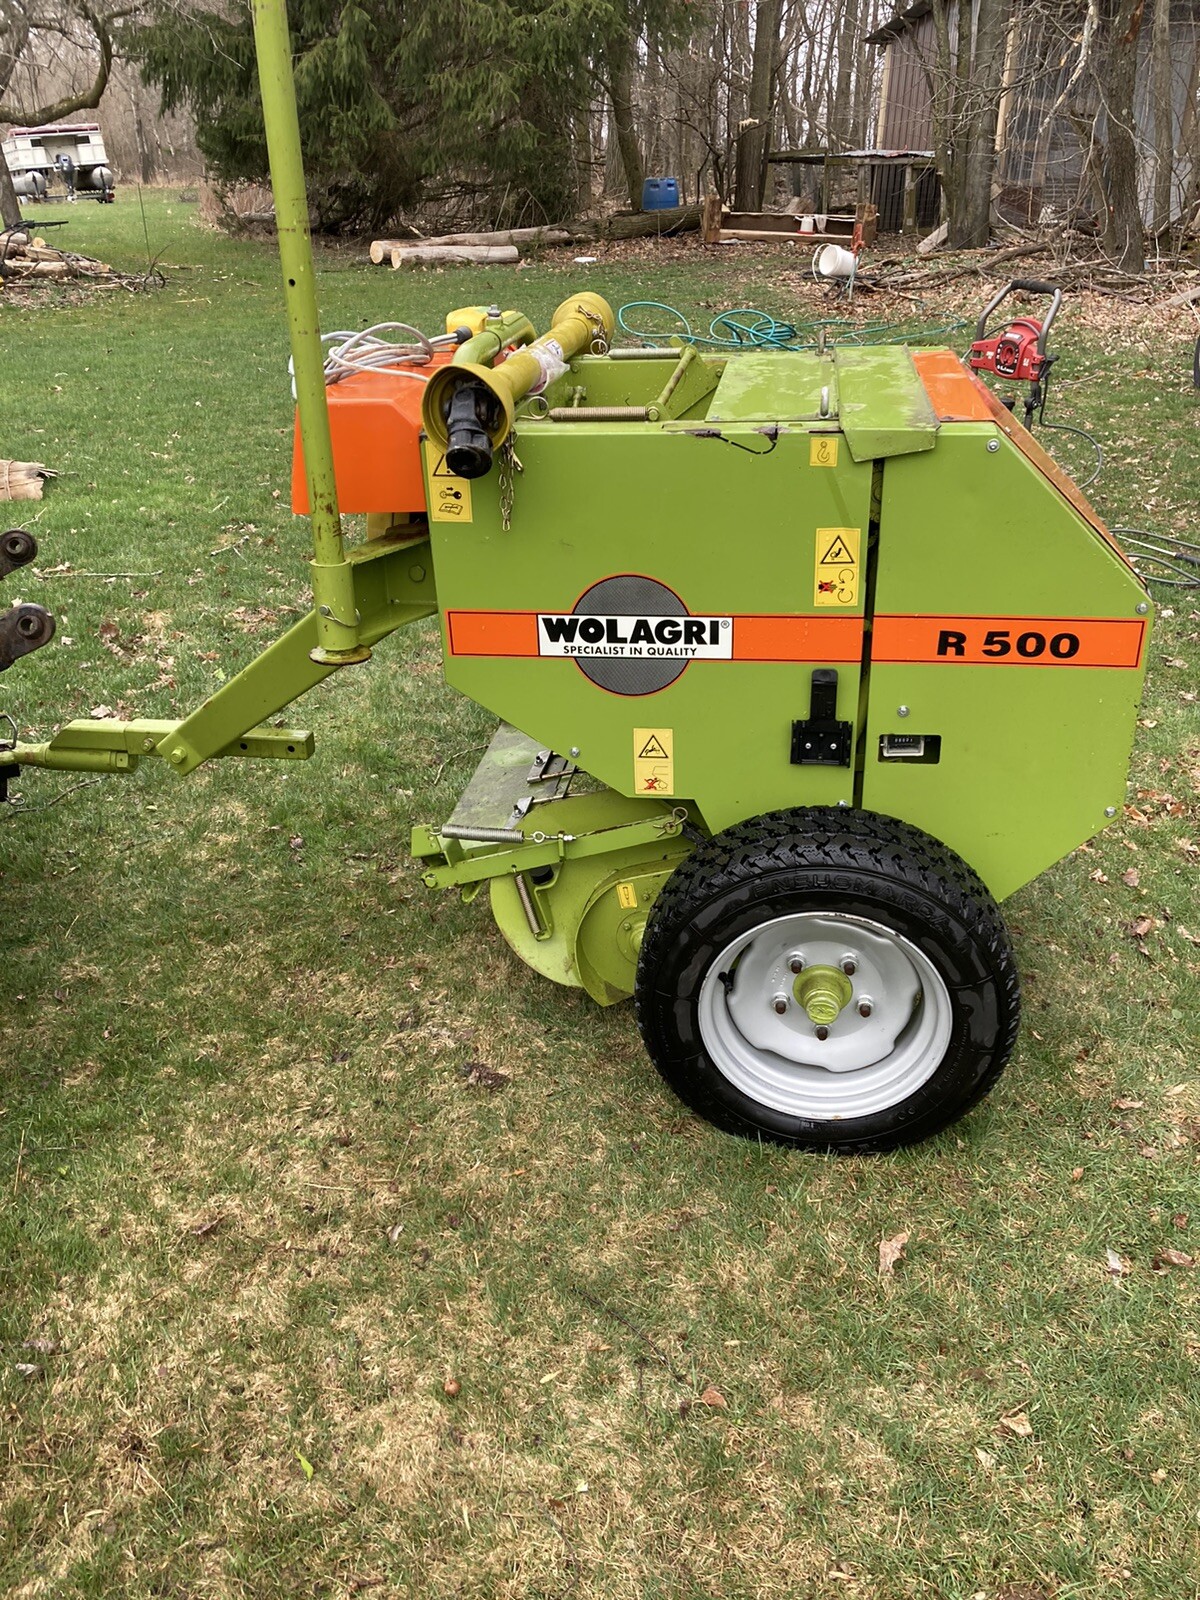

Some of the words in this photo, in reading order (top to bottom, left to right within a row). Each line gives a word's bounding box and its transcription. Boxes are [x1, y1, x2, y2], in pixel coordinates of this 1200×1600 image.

[541, 617, 720, 646] WOLAGRI
[936, 630, 967, 656] R
[981, 630, 1081, 659] 500
[563, 645, 625, 655] SPECIALIST
[629, 647, 643, 655] IN
[647, 646, 698, 656] QUALITY
[752, 873, 952, 934] PNEUSMARCA
